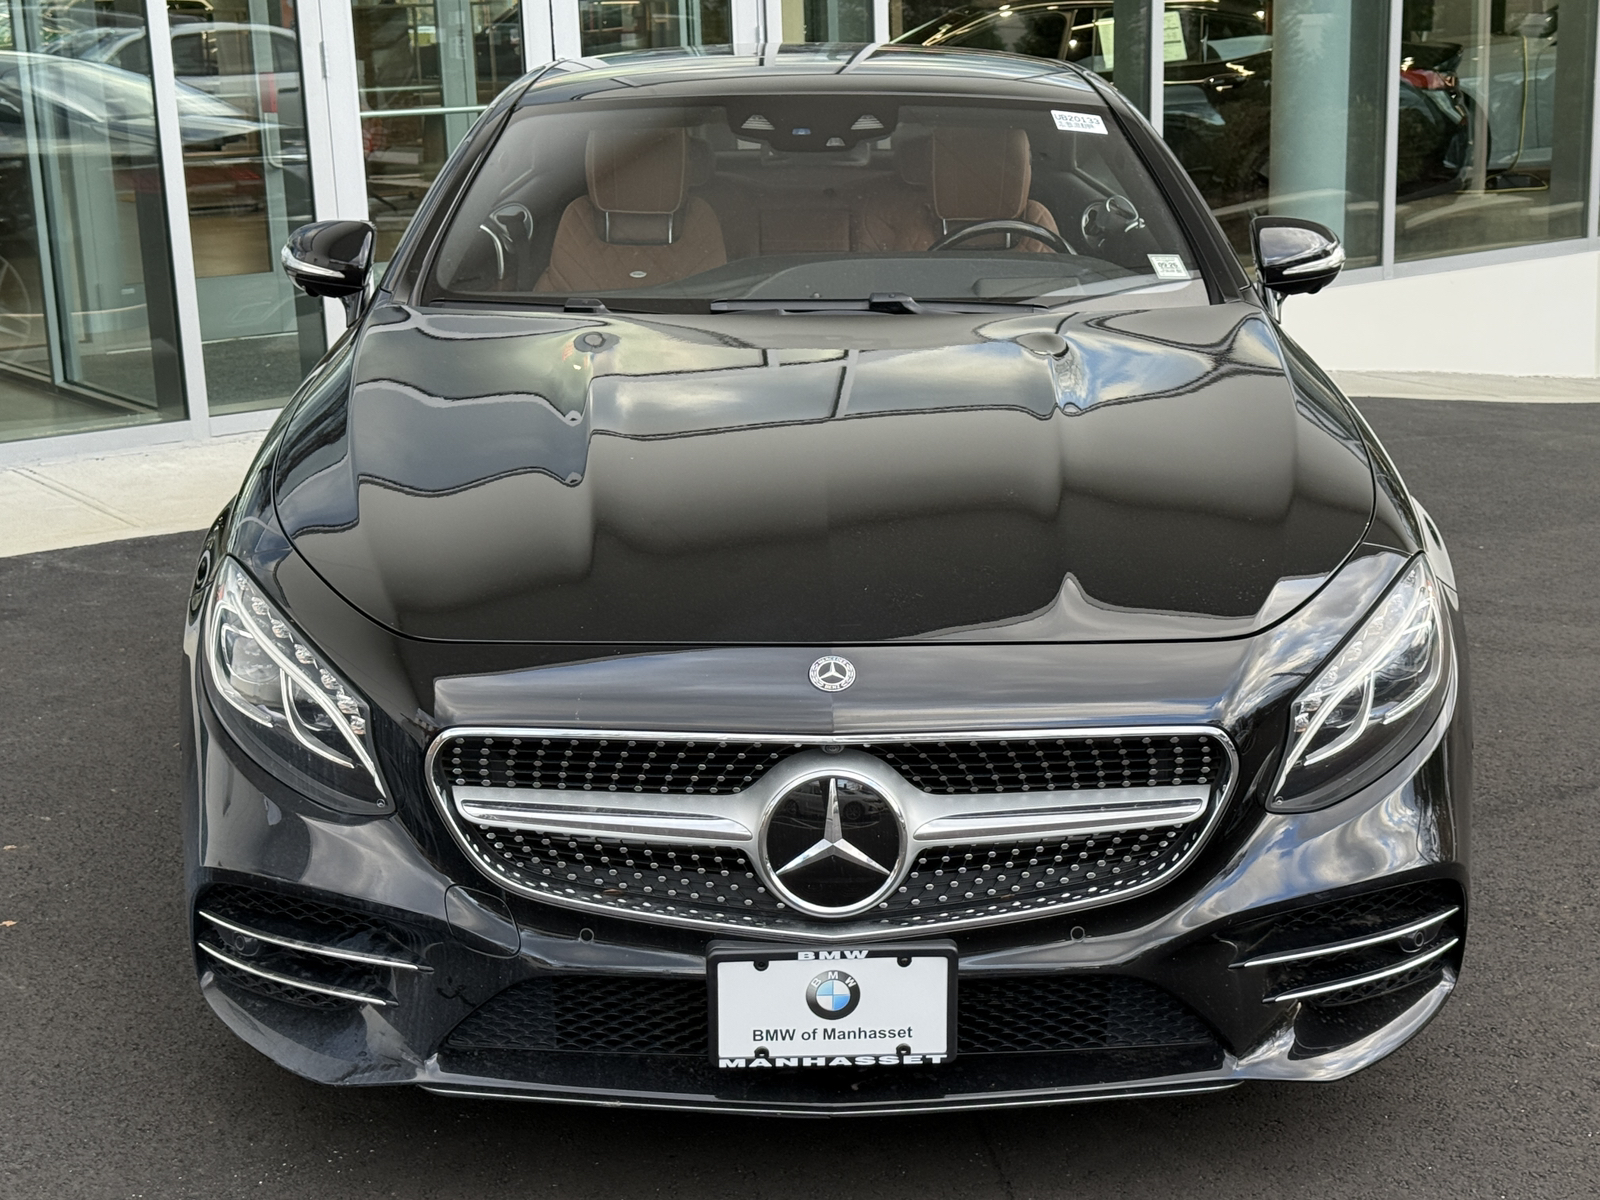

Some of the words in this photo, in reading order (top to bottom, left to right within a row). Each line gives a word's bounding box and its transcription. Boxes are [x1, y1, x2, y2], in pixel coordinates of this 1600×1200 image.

[798, 950, 868, 960] BMW
[811, 971, 856, 988] BMW
[752, 1029, 796, 1041] BMW
[801, 1028, 818, 1040] of
[823, 1026, 913, 1040] Manhasset
[718, 1054, 947, 1068] MANHASSET
